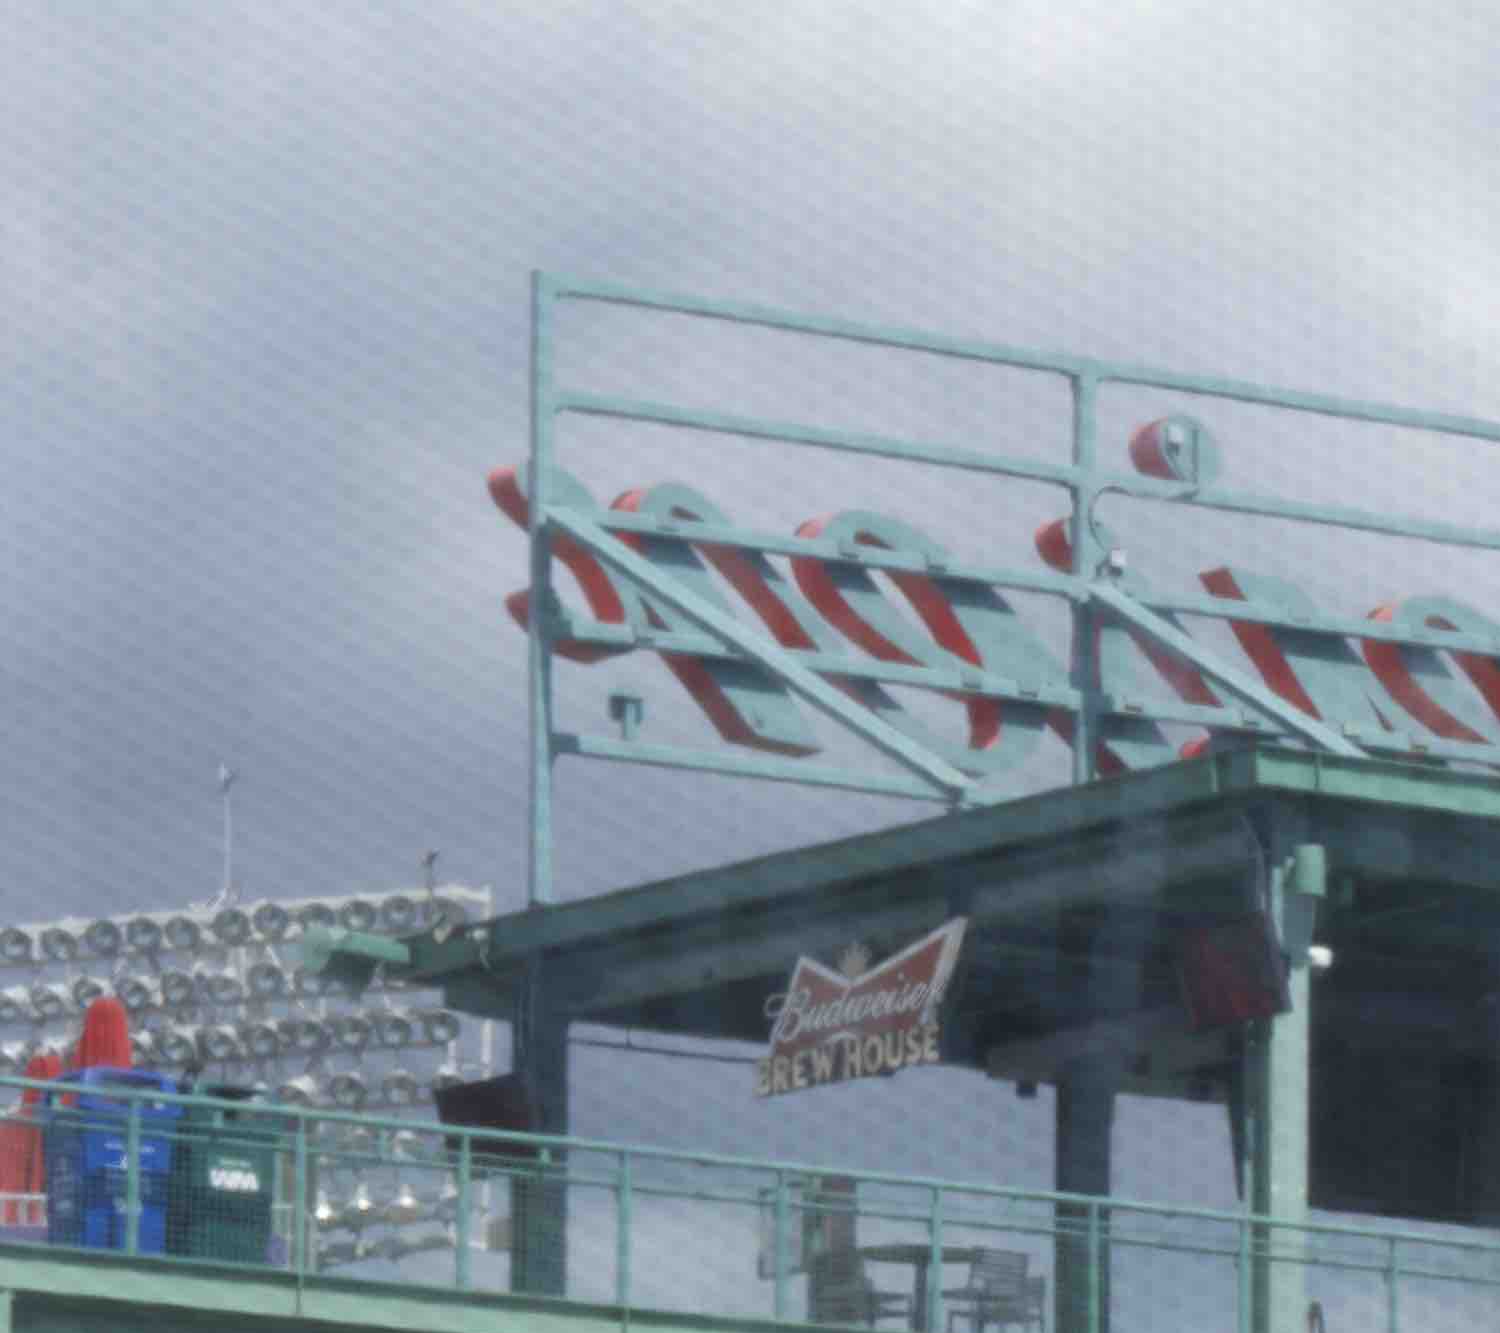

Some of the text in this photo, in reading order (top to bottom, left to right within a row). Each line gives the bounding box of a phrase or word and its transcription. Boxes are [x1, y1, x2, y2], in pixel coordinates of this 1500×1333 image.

[764, 968, 947, 1042] Budweiser
[754, 1023, 941, 1097] BREW HOUSE
